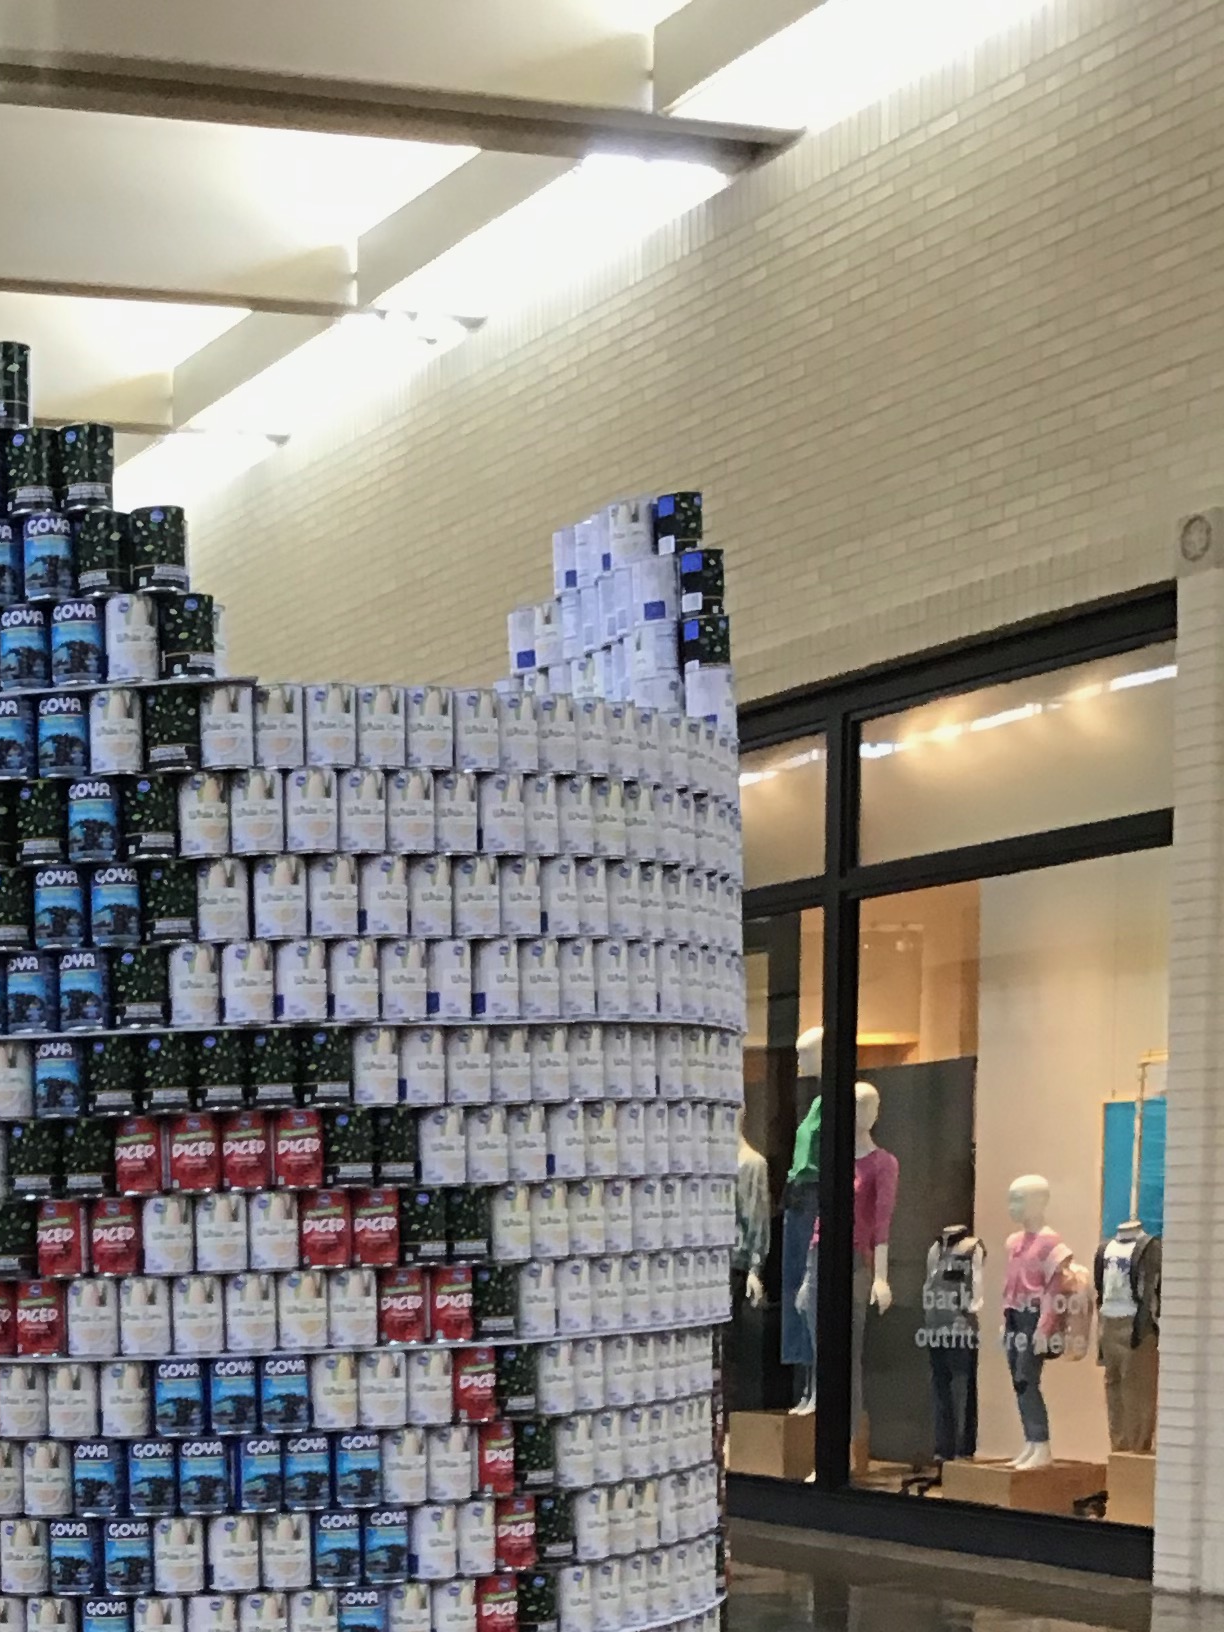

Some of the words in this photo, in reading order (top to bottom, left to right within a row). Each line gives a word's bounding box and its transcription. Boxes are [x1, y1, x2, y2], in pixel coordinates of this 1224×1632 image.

[116, 1144, 156, 1160] DICED
[172, 1141, 215, 1158] DICED
[223, 1139, 266, 1156] DICED
[277, 1138, 321, 1155] DICED
[303, 1218, 345, 1234] DICED
[354, 1217, 397, 1232] DICED
[37, 1228, 74, 1243] DICED
[93, 1227, 135, 1242] DICED
[381, 1294, 423, 1310] DICED
[922, 1282, 973, 1311] back
[17, 1307, 58, 1323] DICED
